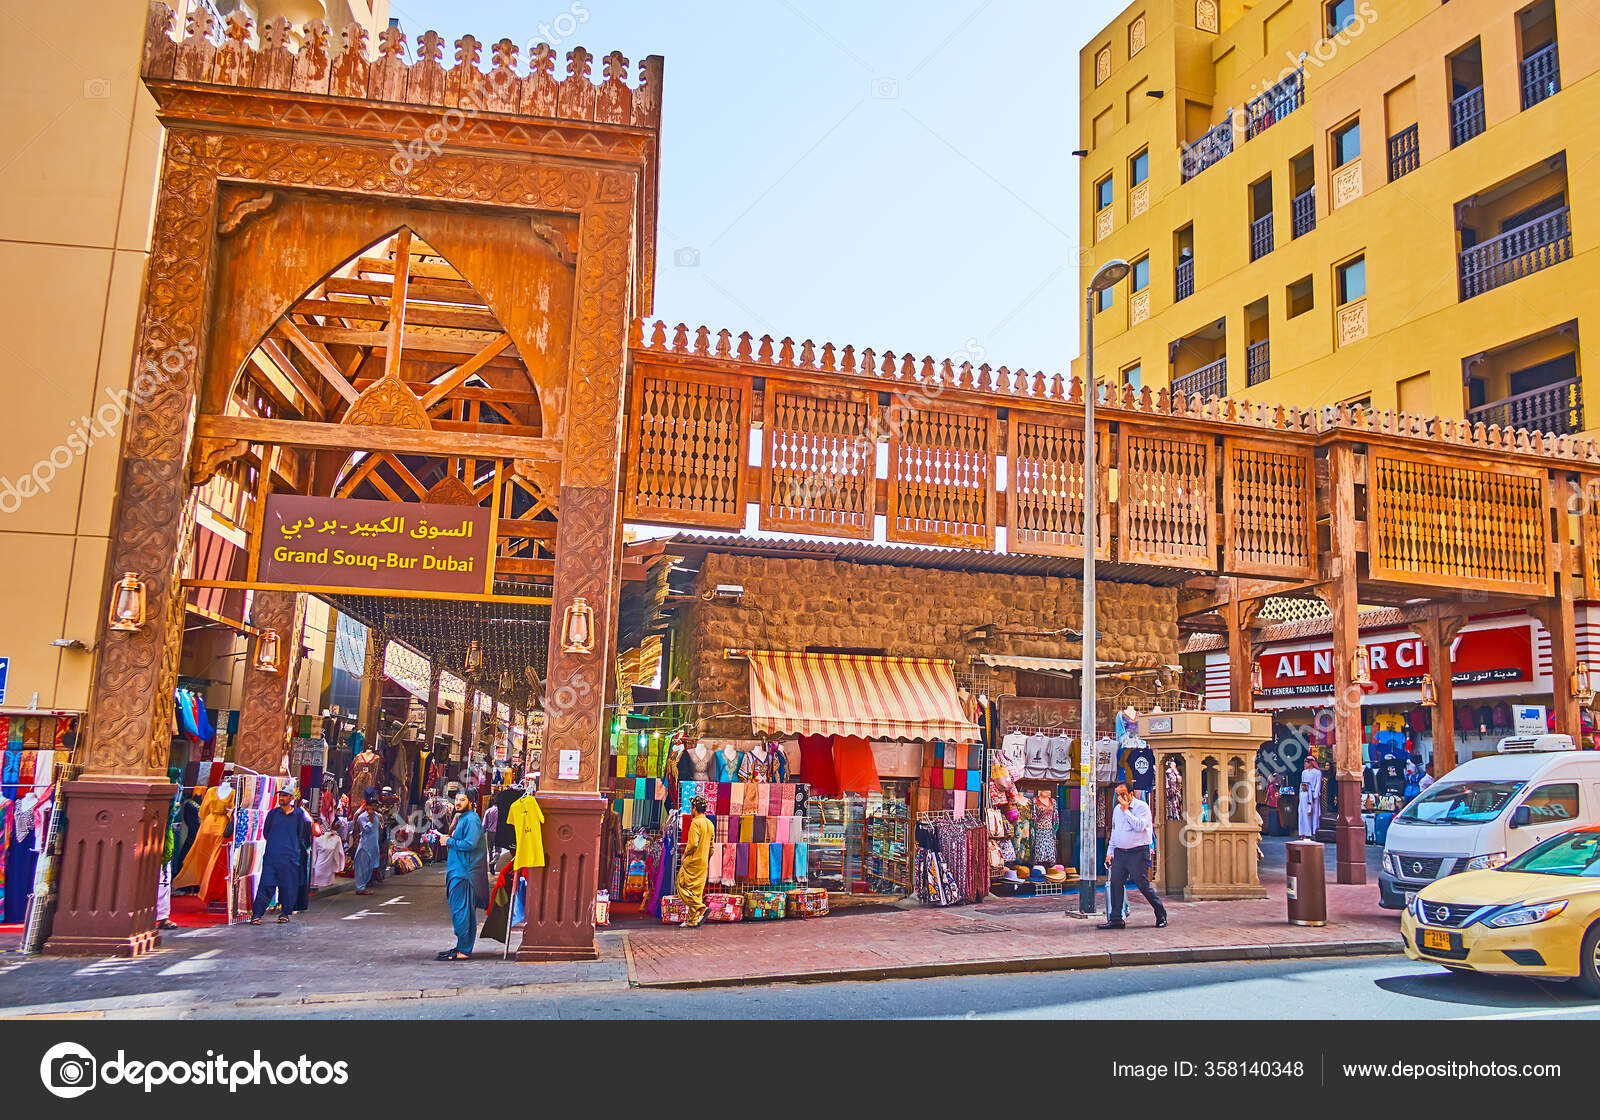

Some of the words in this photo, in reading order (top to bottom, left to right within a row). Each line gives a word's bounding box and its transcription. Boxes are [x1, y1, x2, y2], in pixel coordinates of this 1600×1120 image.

[281, 516, 315, 540] دبي
[410, 520, 473, 539] السوق
[273, 546, 328, 564] Grand
[333, 549, 418, 570] Souq-Bur
[422, 555, 474, 572] Dubai
[1275, 655, 1307, 679] AL
[1314, 646, 1389, 675] NR
[1395, 635, 1464, 669] CIY
[1472, 672, 1491, 682] النور
[1494, 671, 1517, 680] مدينة
[1272, 686, 1296, 696] GENERAL
[1296, 685, 1319, 694] TRADING
